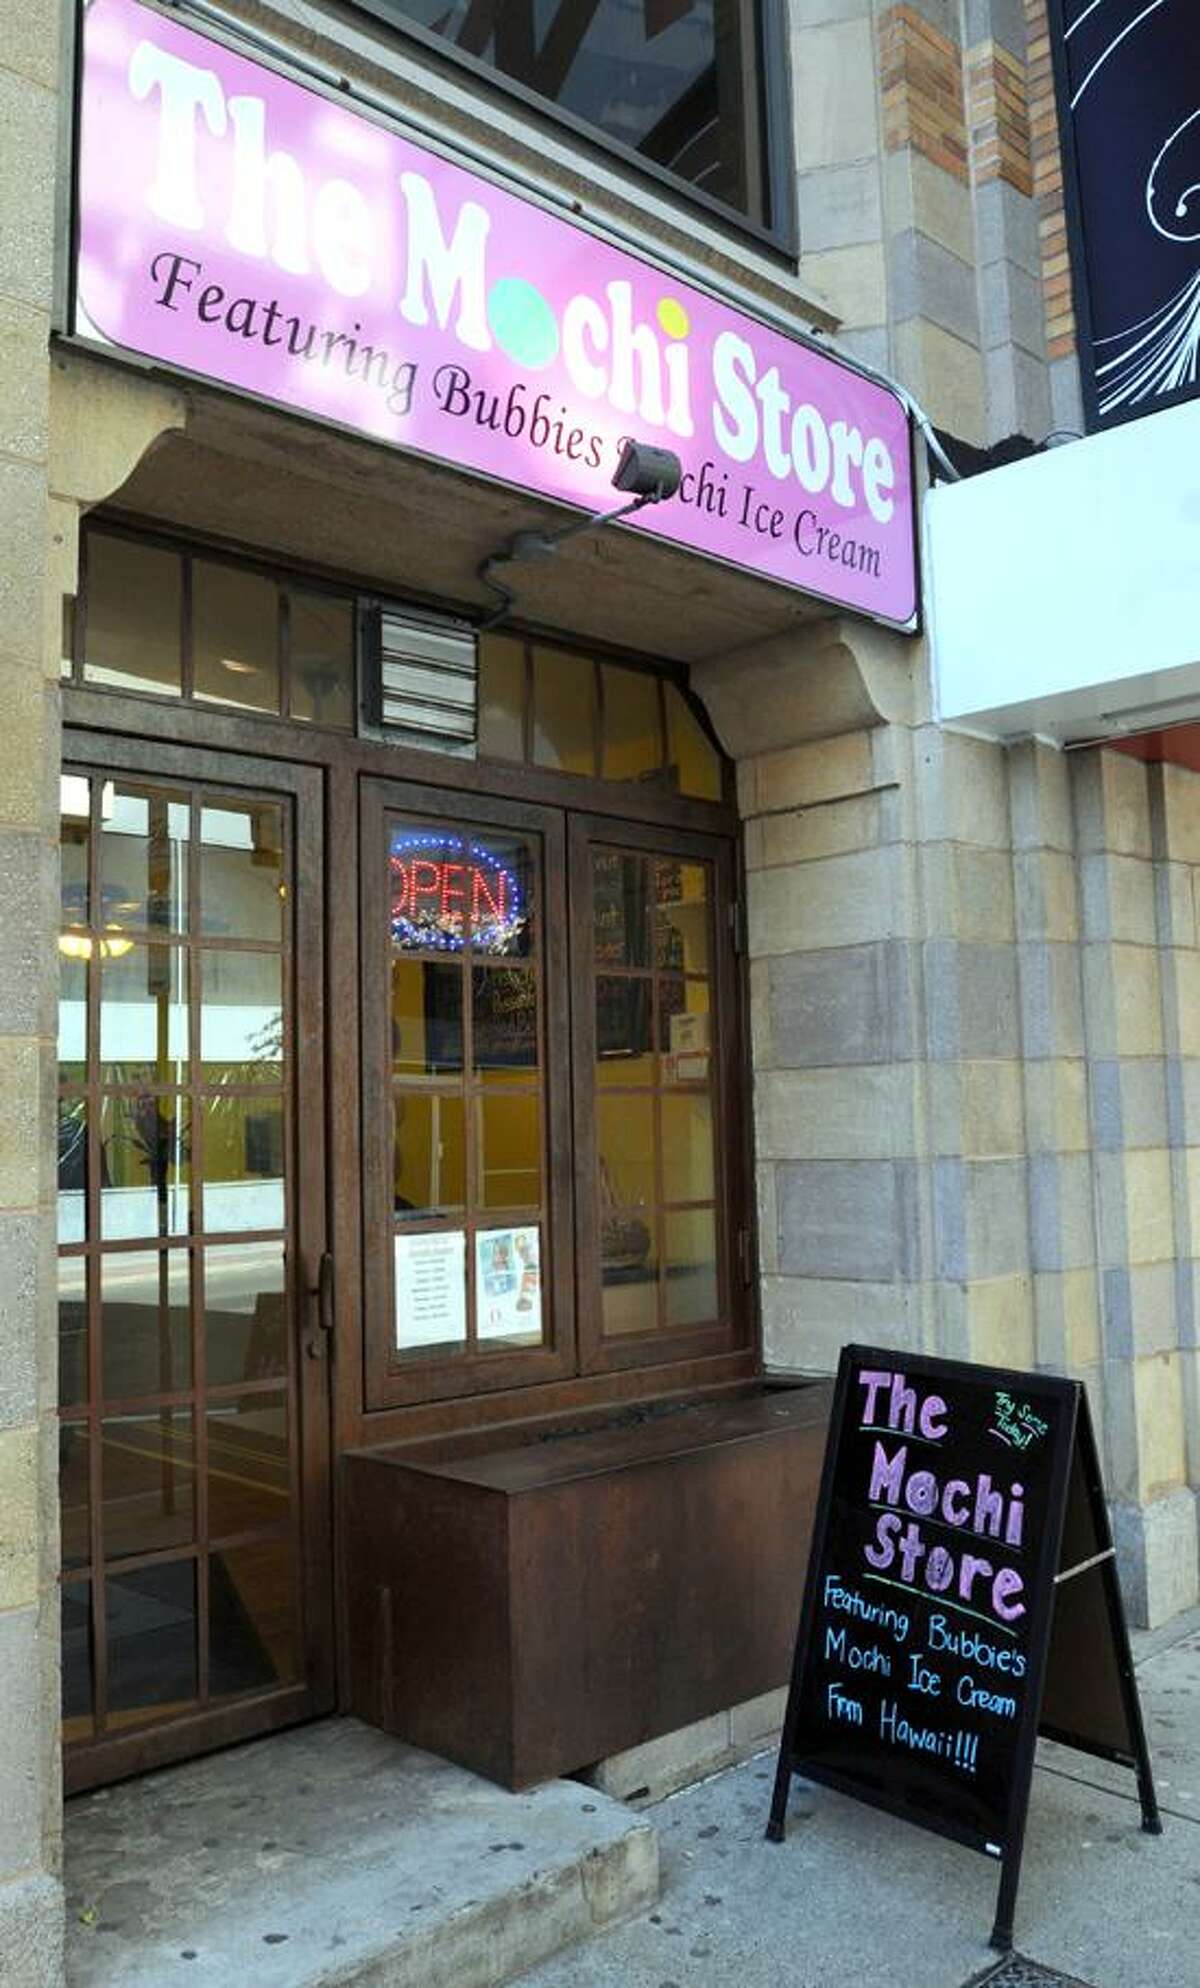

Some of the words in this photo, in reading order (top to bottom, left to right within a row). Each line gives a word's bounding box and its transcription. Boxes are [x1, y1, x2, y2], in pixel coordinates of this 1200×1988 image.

[129, 40, 373, 296] The
[401, 171, 694, 437] Mochi
[713, 331, 895, 523] Store
[150, 252, 417, 415] Featuring
[433, 364, 602, 467] Bubbies
[738, 483, 783, 539] Ice
[794, 510, 880, 577] Cream
[859, 1370, 948, 1439] The
[868, 1440, 1024, 1546] Mochi
[864, 1513, 1026, 1621] Store
[824, 1575, 909, 1642] Featuring
[928, 1614, 1026, 1677] Bubbie's
[824, 1627, 891, 1677] Mochi
[907, 1654, 941, 1696] Ice
[956, 1675, 1016, 1718] Cream
[879, 1699, 979, 1774] Hawaii!!!
